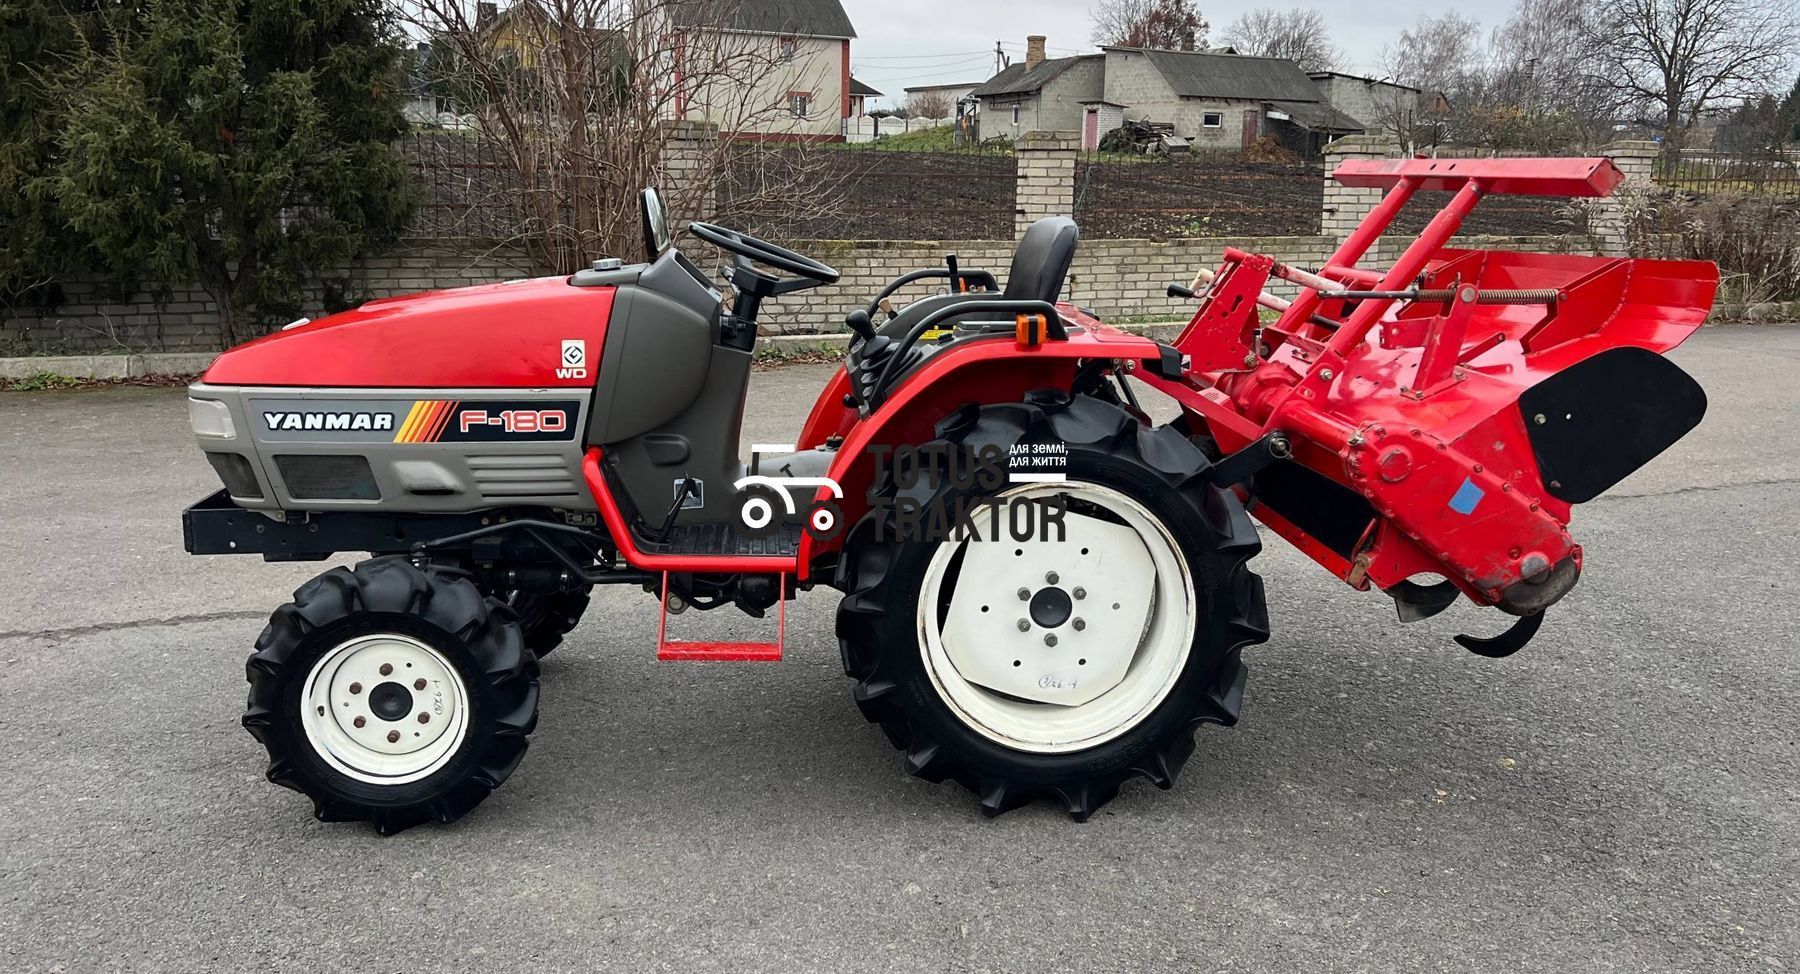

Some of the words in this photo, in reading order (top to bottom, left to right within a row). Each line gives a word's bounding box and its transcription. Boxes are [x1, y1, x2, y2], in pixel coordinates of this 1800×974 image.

[555, 368, 587, 379] WD
[264, 412, 395, 431] YANMAR
[459, 409, 567, 433] F-180
